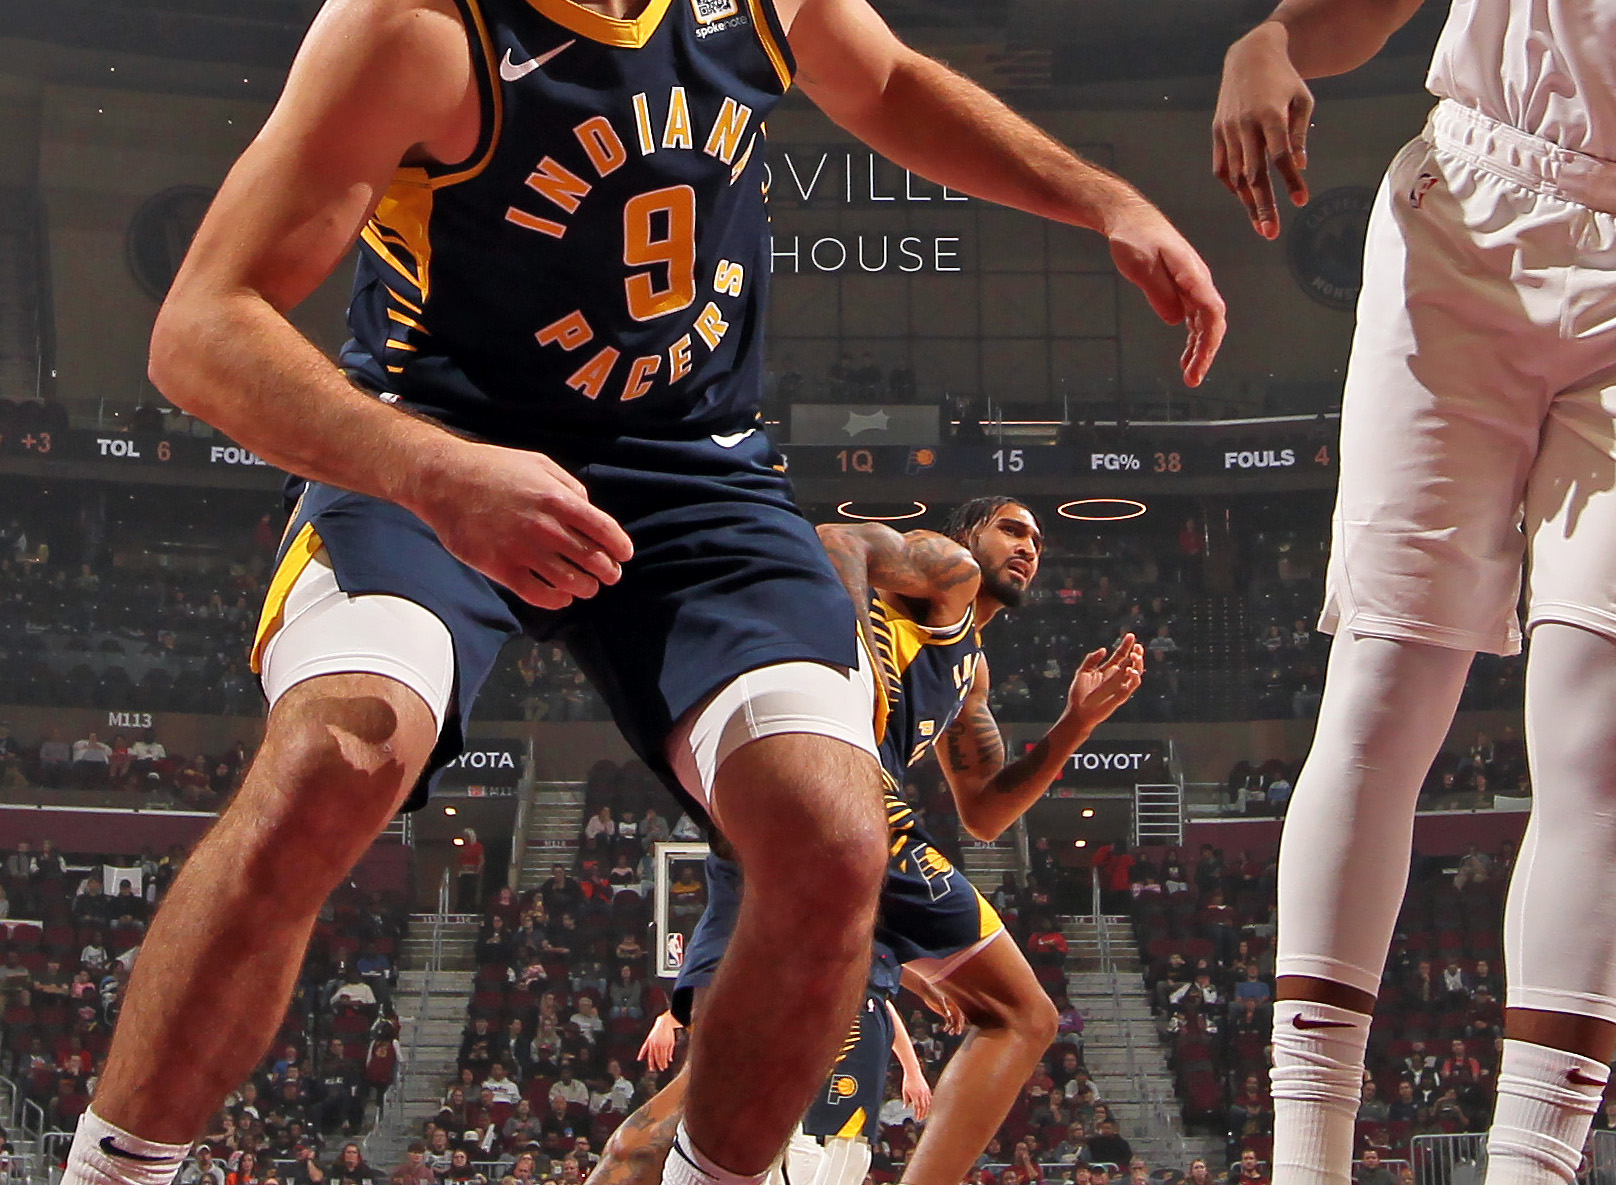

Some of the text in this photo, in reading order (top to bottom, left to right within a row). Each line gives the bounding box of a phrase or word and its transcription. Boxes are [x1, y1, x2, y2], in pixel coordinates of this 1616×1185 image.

[622, 182, 697, 323] 9
[534, 258, 745, 402] PACERS
[20, 432, 52, 453] +3
[96, 437, 141, 458] TOL
[156, 441, 171, 461] 6
[836, 445, 1330, 473] 1Q 15 FG% 38 FOULS 4
[108, 711, 153, 728] M113
